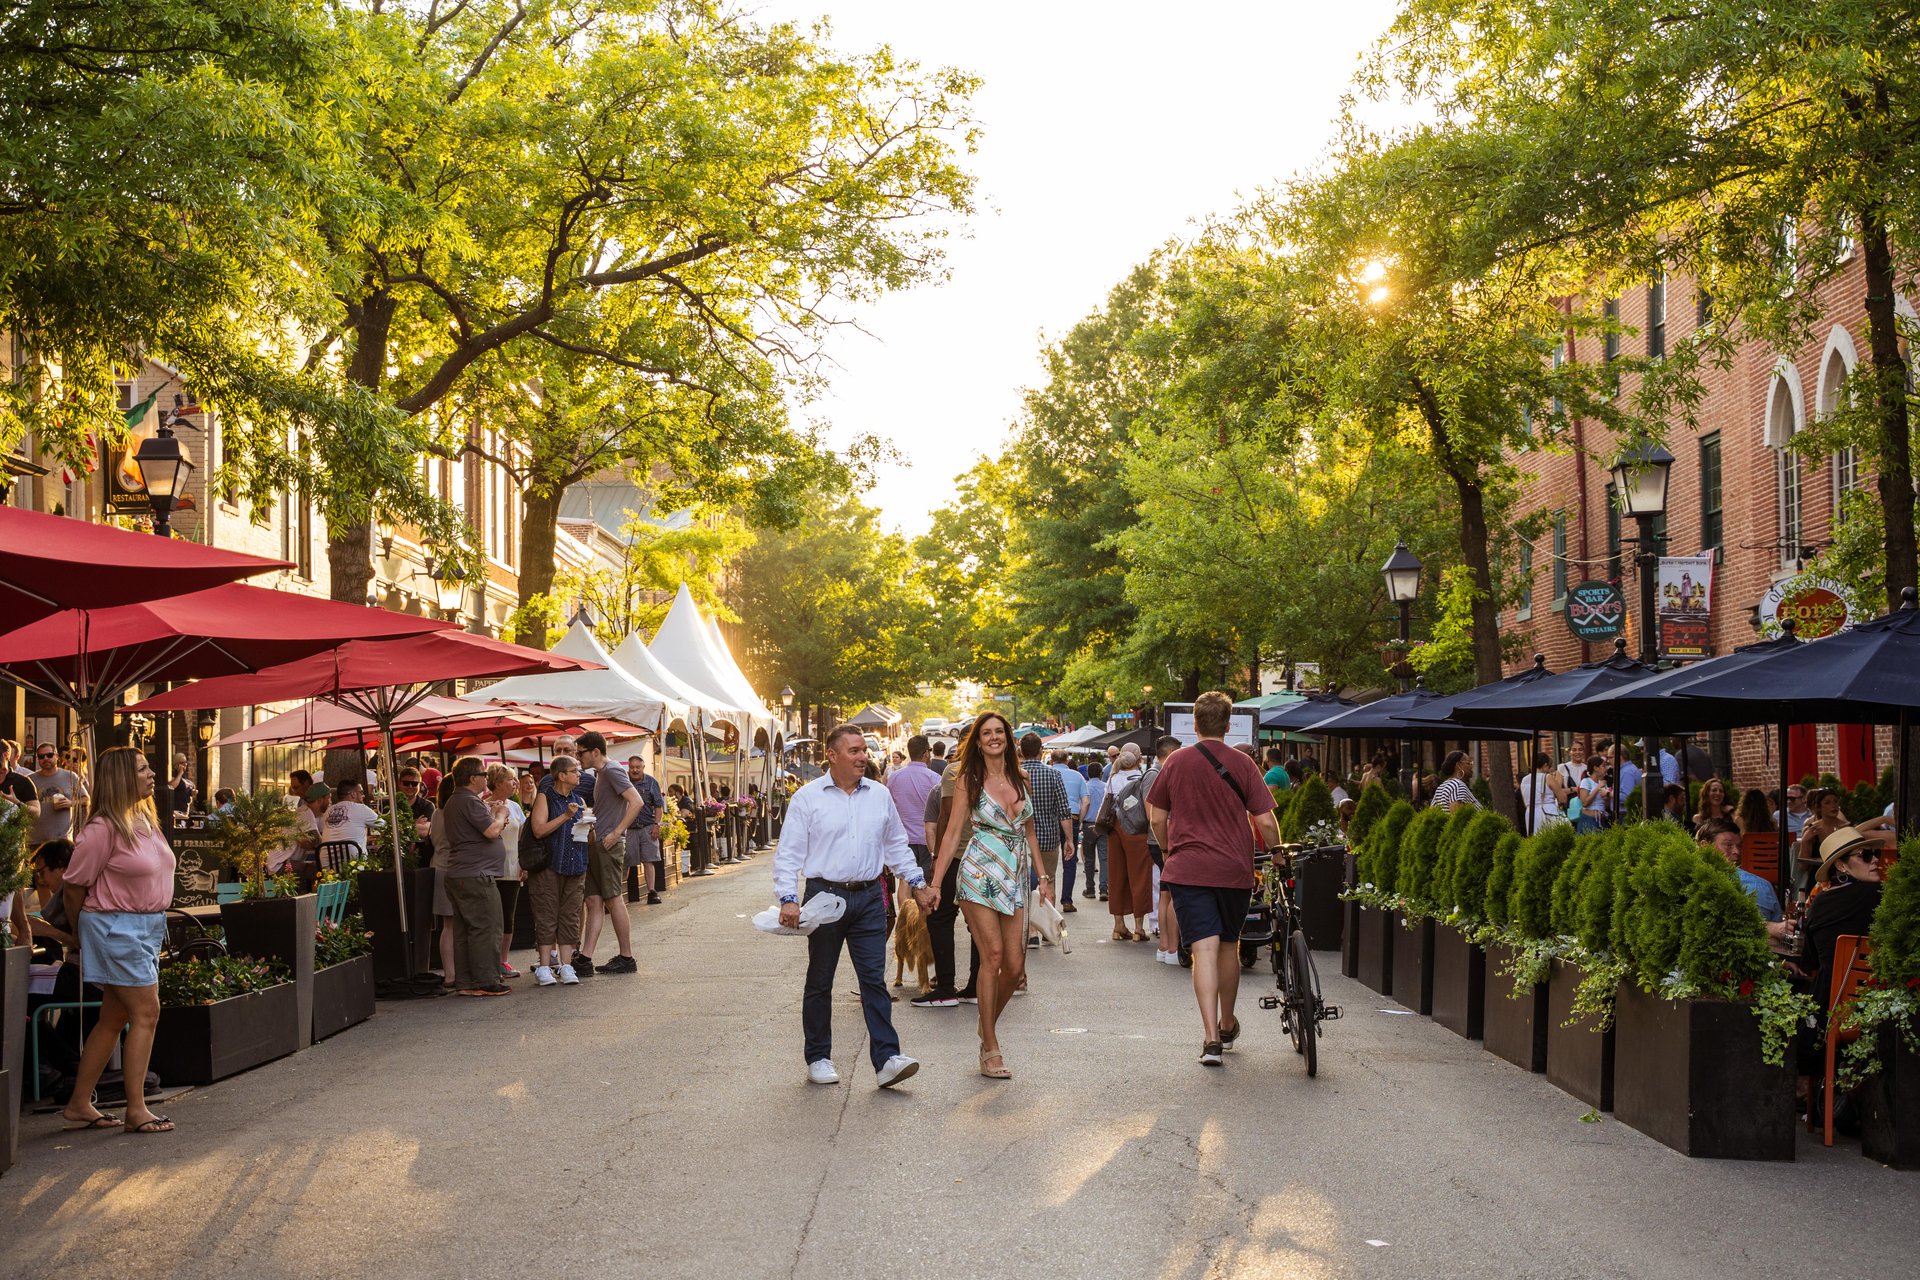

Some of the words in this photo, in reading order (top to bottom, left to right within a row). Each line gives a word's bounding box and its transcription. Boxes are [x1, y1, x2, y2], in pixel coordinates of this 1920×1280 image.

[1578, 588, 1610, 597] SPORTS
[1579, 626, 1617, 635] UPSTAIRS
[1663, 623, 1708, 634] SPEED
[1663, 635, 1708, 647] STYLE
